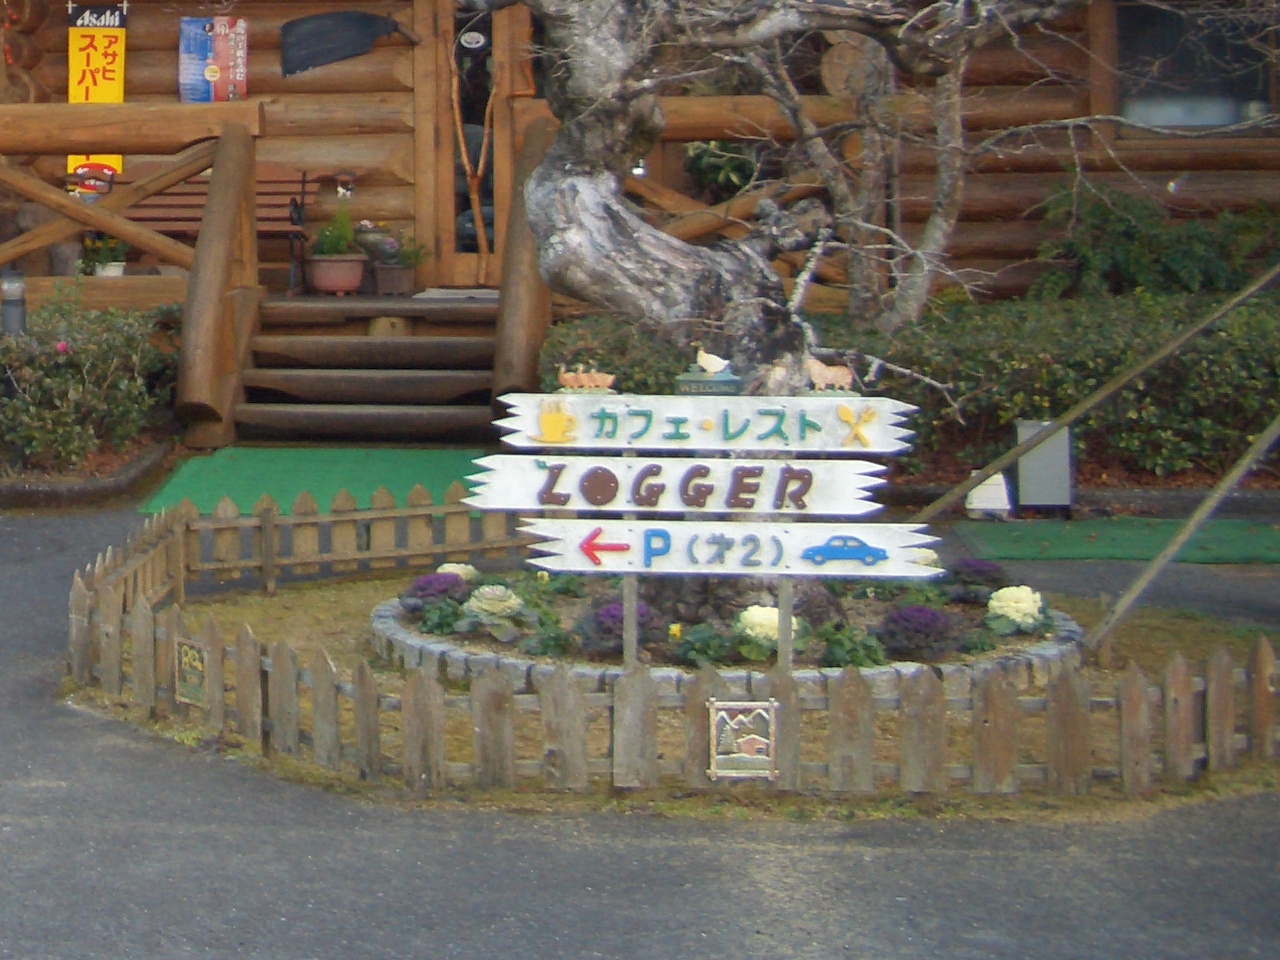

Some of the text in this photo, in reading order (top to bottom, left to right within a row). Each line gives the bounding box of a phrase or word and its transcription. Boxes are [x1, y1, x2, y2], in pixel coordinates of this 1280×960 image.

[76, 8, 120, 27] Asahi
[101, 34, 119, 82] アサヒ
[590, 407, 822, 441] カフェ・レスト
